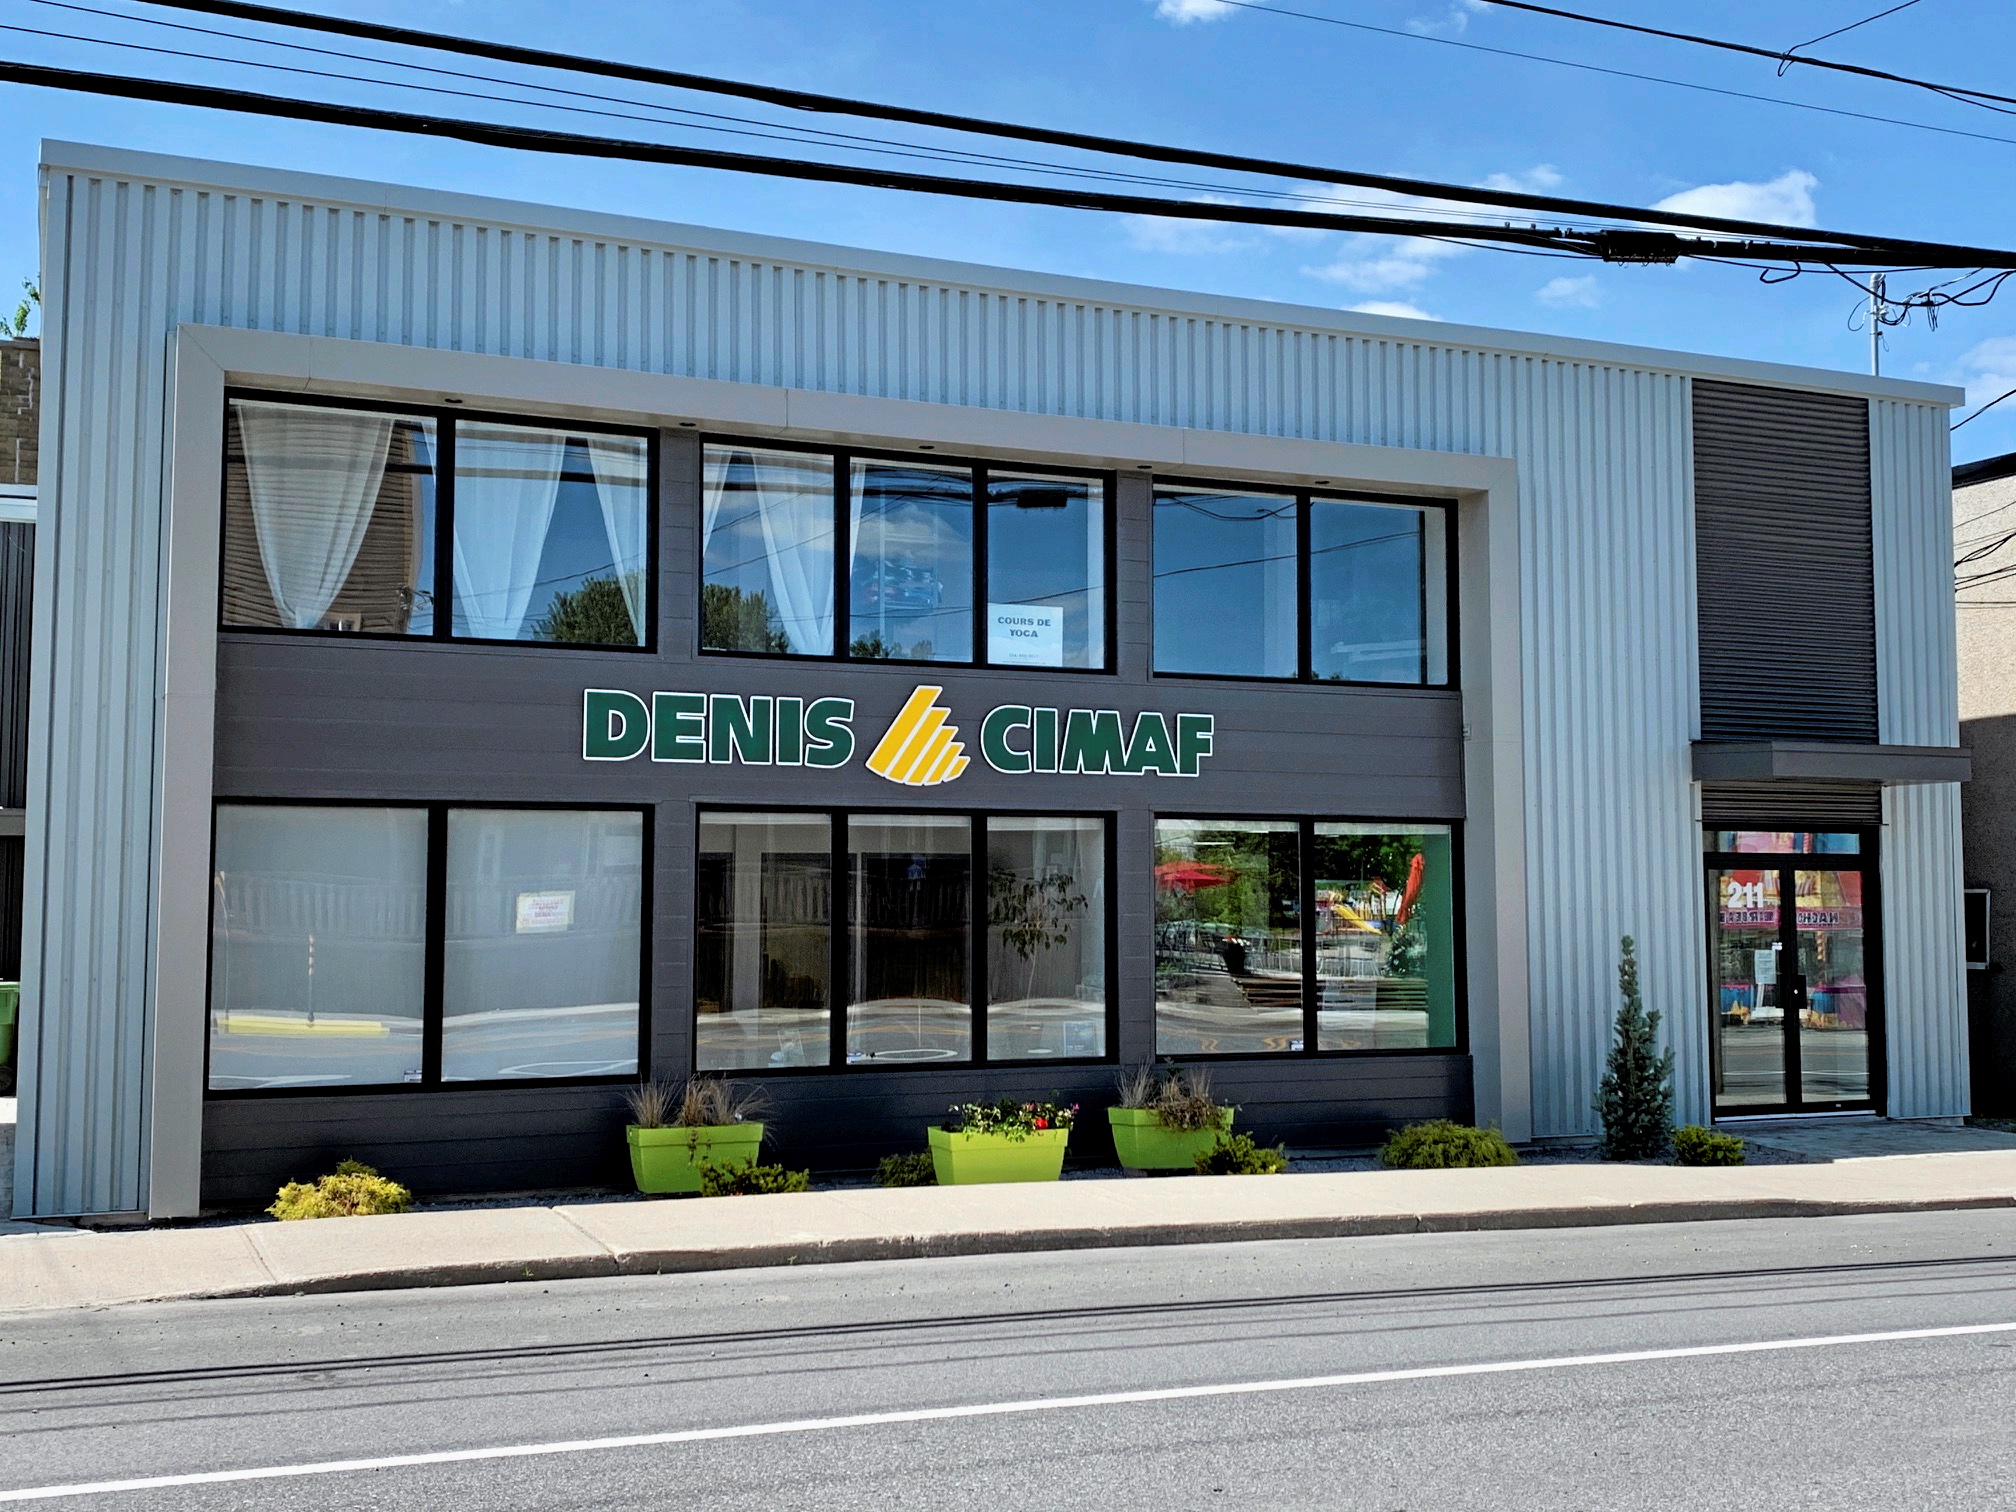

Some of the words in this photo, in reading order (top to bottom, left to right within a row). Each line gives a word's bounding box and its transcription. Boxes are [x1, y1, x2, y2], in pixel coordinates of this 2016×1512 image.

[997, 616, 1034, 626] COURS
[1037, 618, 1051, 627] DE
[583, 688, 855, 769] DENIS
[980, 704, 1214, 777] CIMAF
[1727, 881, 1763, 908] 211
